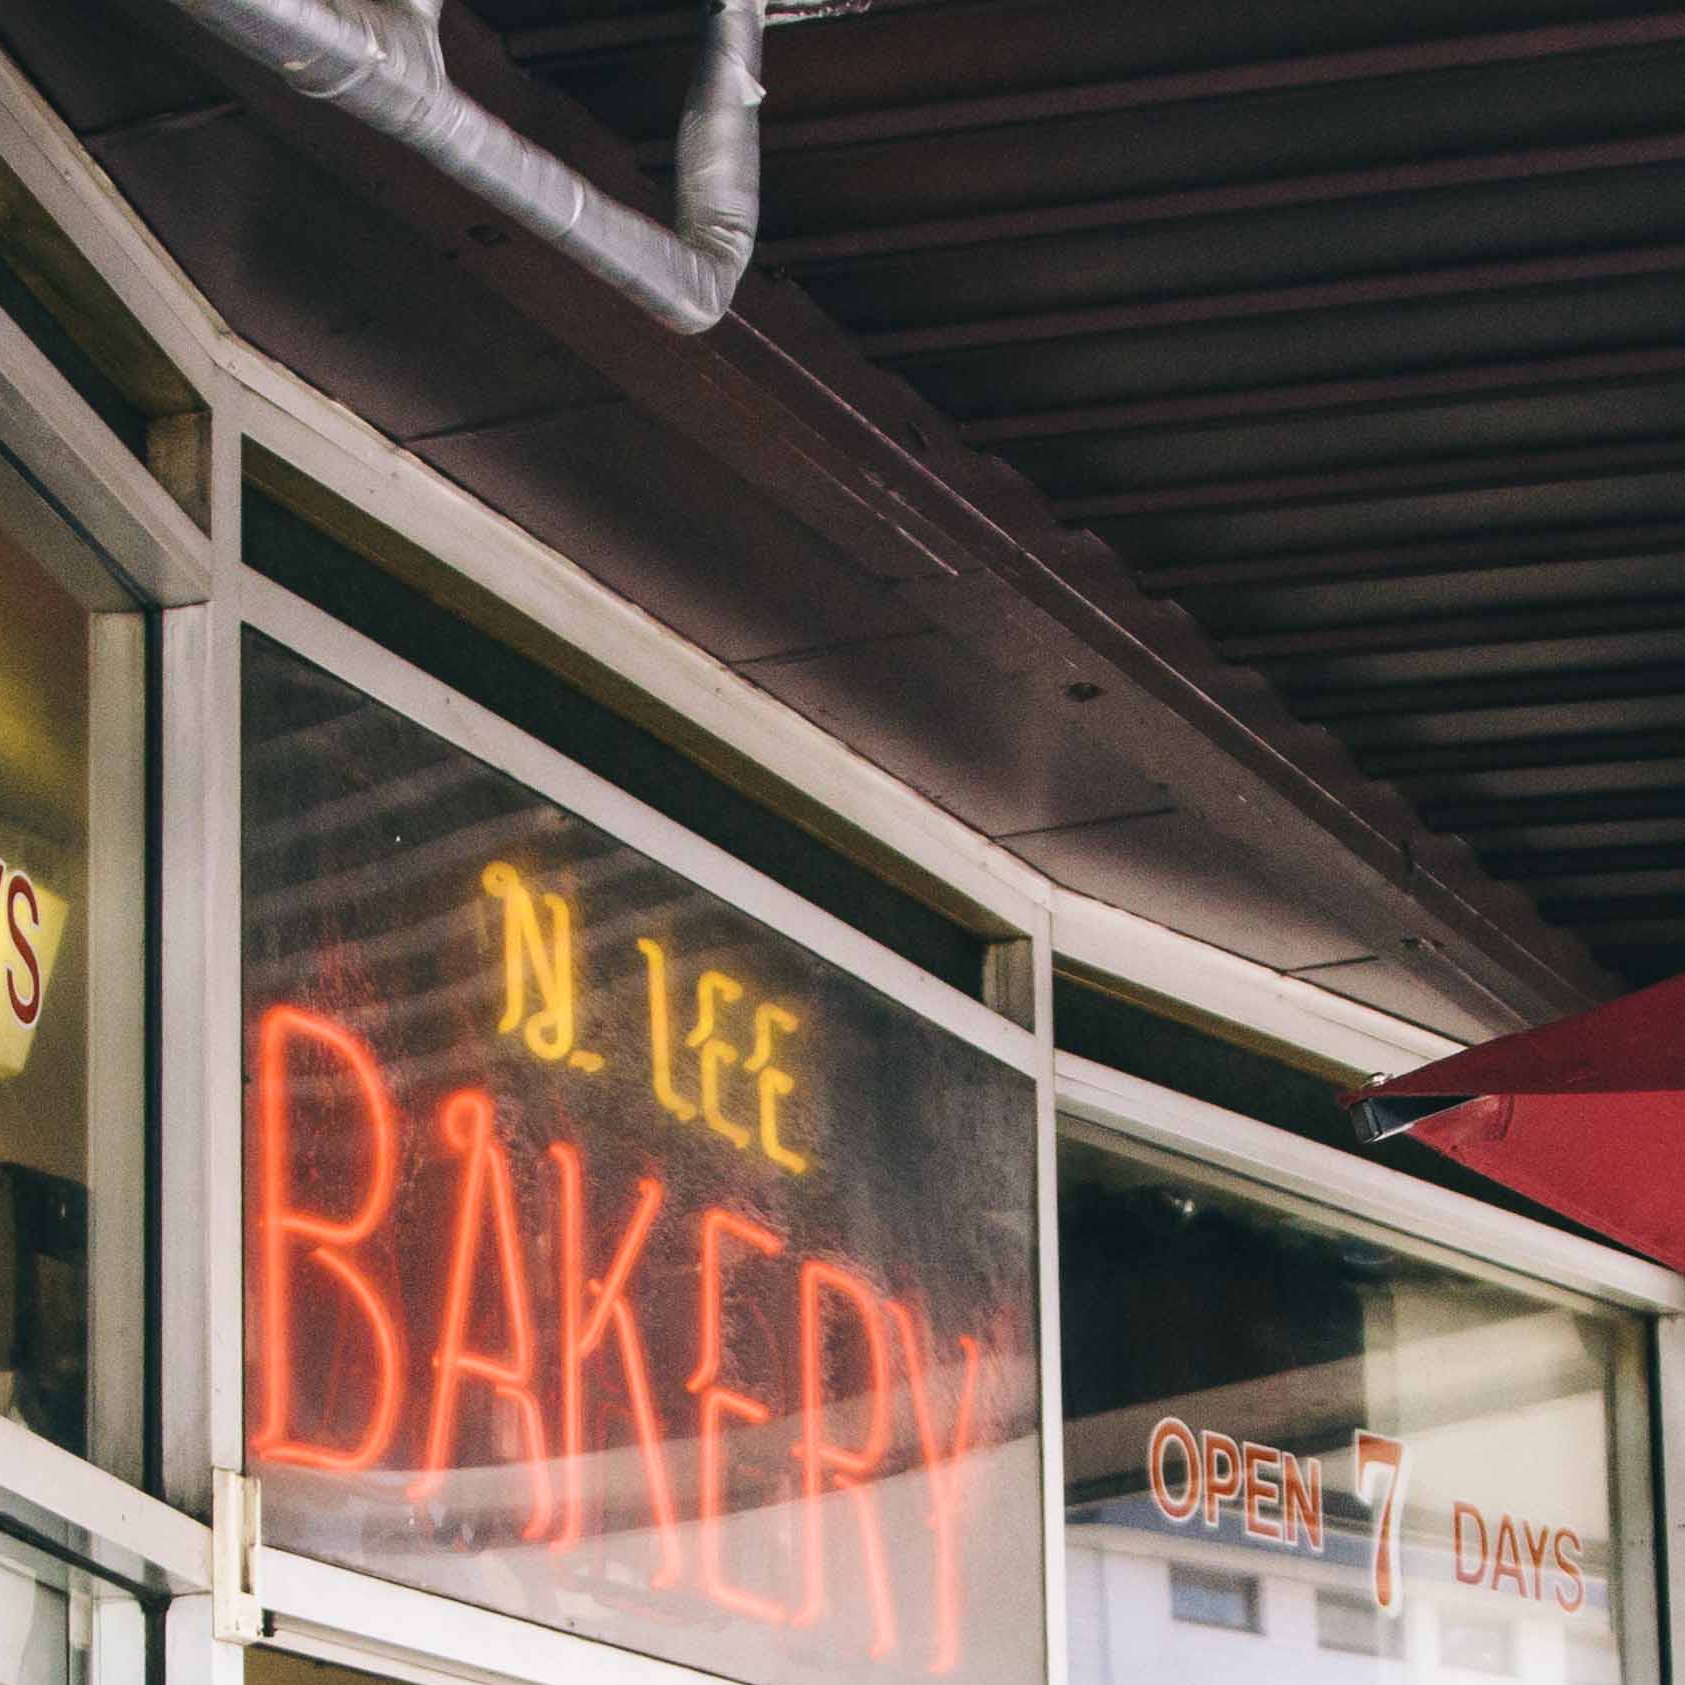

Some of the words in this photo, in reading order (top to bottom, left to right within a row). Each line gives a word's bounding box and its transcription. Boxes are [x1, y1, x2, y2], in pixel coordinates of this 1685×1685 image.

[636, 937, 813, 1174] LEE
[251, 1003, 985, 1677] BAKERY
[1147, 1416, 1324, 1552] OPEN
[1354, 1428, 1406, 1617] 7
[1452, 1501, 1586, 1614] DAYS
